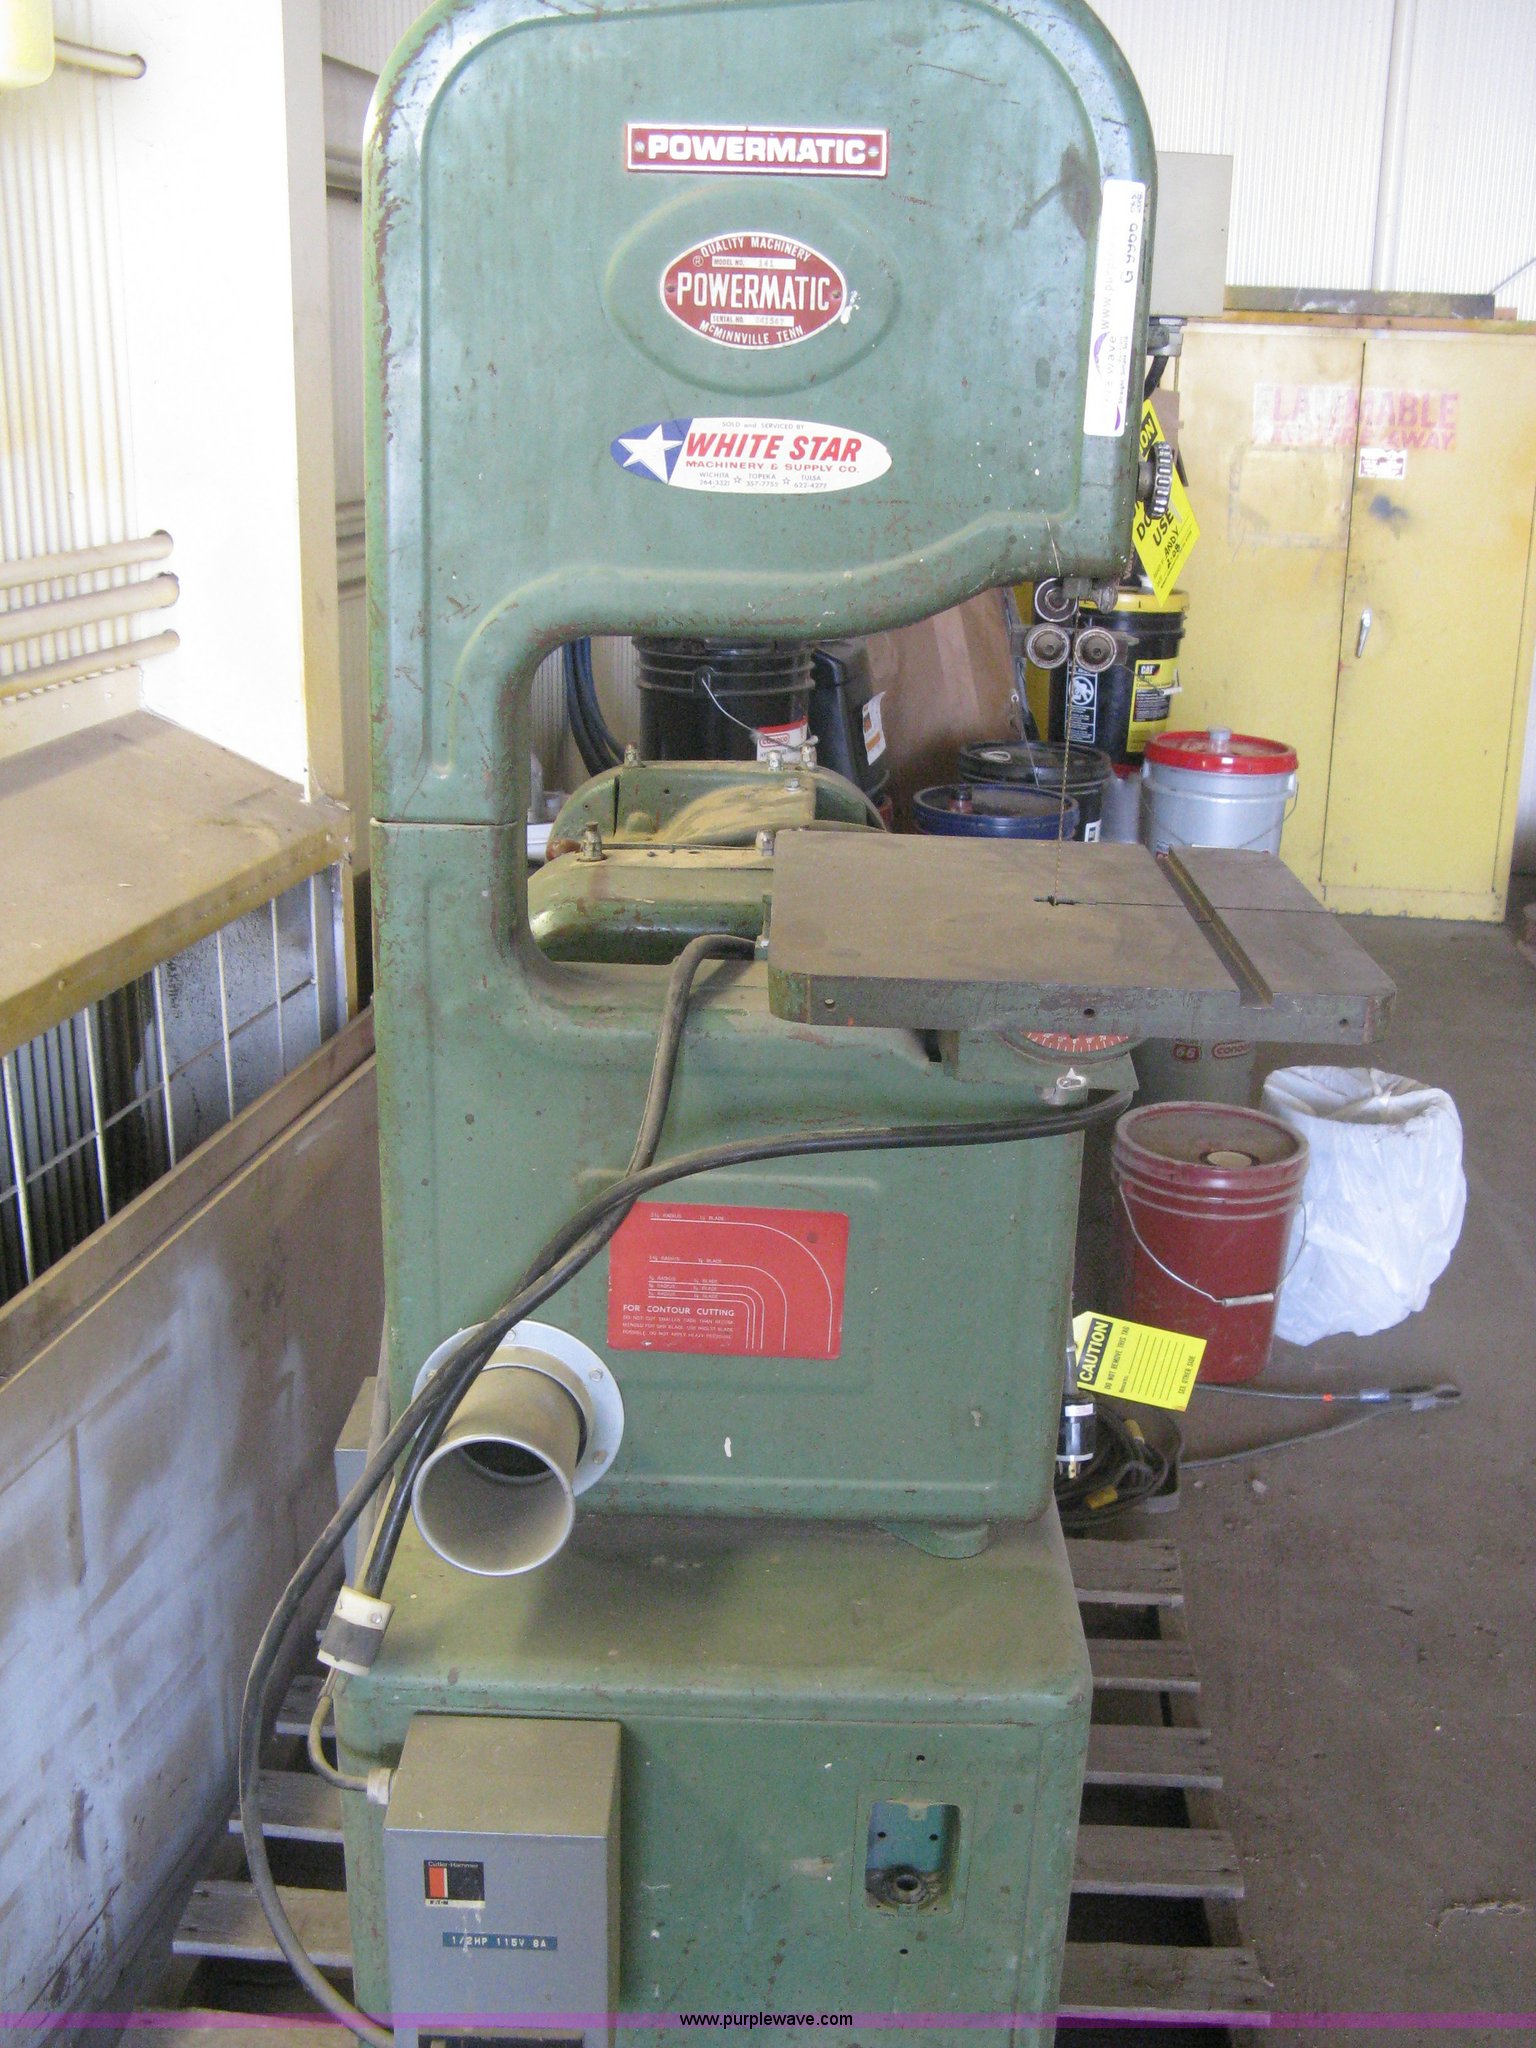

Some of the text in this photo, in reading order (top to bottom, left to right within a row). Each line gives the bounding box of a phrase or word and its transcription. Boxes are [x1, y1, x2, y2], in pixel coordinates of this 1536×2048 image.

[648, 134, 867, 165] POWERMATIC
[700, 236, 812, 262] QUALITY MACHINERY
[677, 271, 831, 311] POWERMATIC
[761, 422, 794, 430] SERVICED
[686, 432, 862, 462] WHITE STAR
[686, 461, 765, 470] MACHINERY
[770, 463, 779, 471] &
[785, 463, 833, 472] SUPPLY
[1152, 507, 1174, 547] USE
[1140, 665, 1155, 675] CAT
[623, 1304, 735, 1317] FOR CONTOUR CUTTING
[1079, 1321, 1109, 1382] CAUTION
[1110, 1349, 1123, 1370] REMOVE
[452, 1935, 488, 1946] 1/2HP
[496, 1936, 525, 1948] 115V
